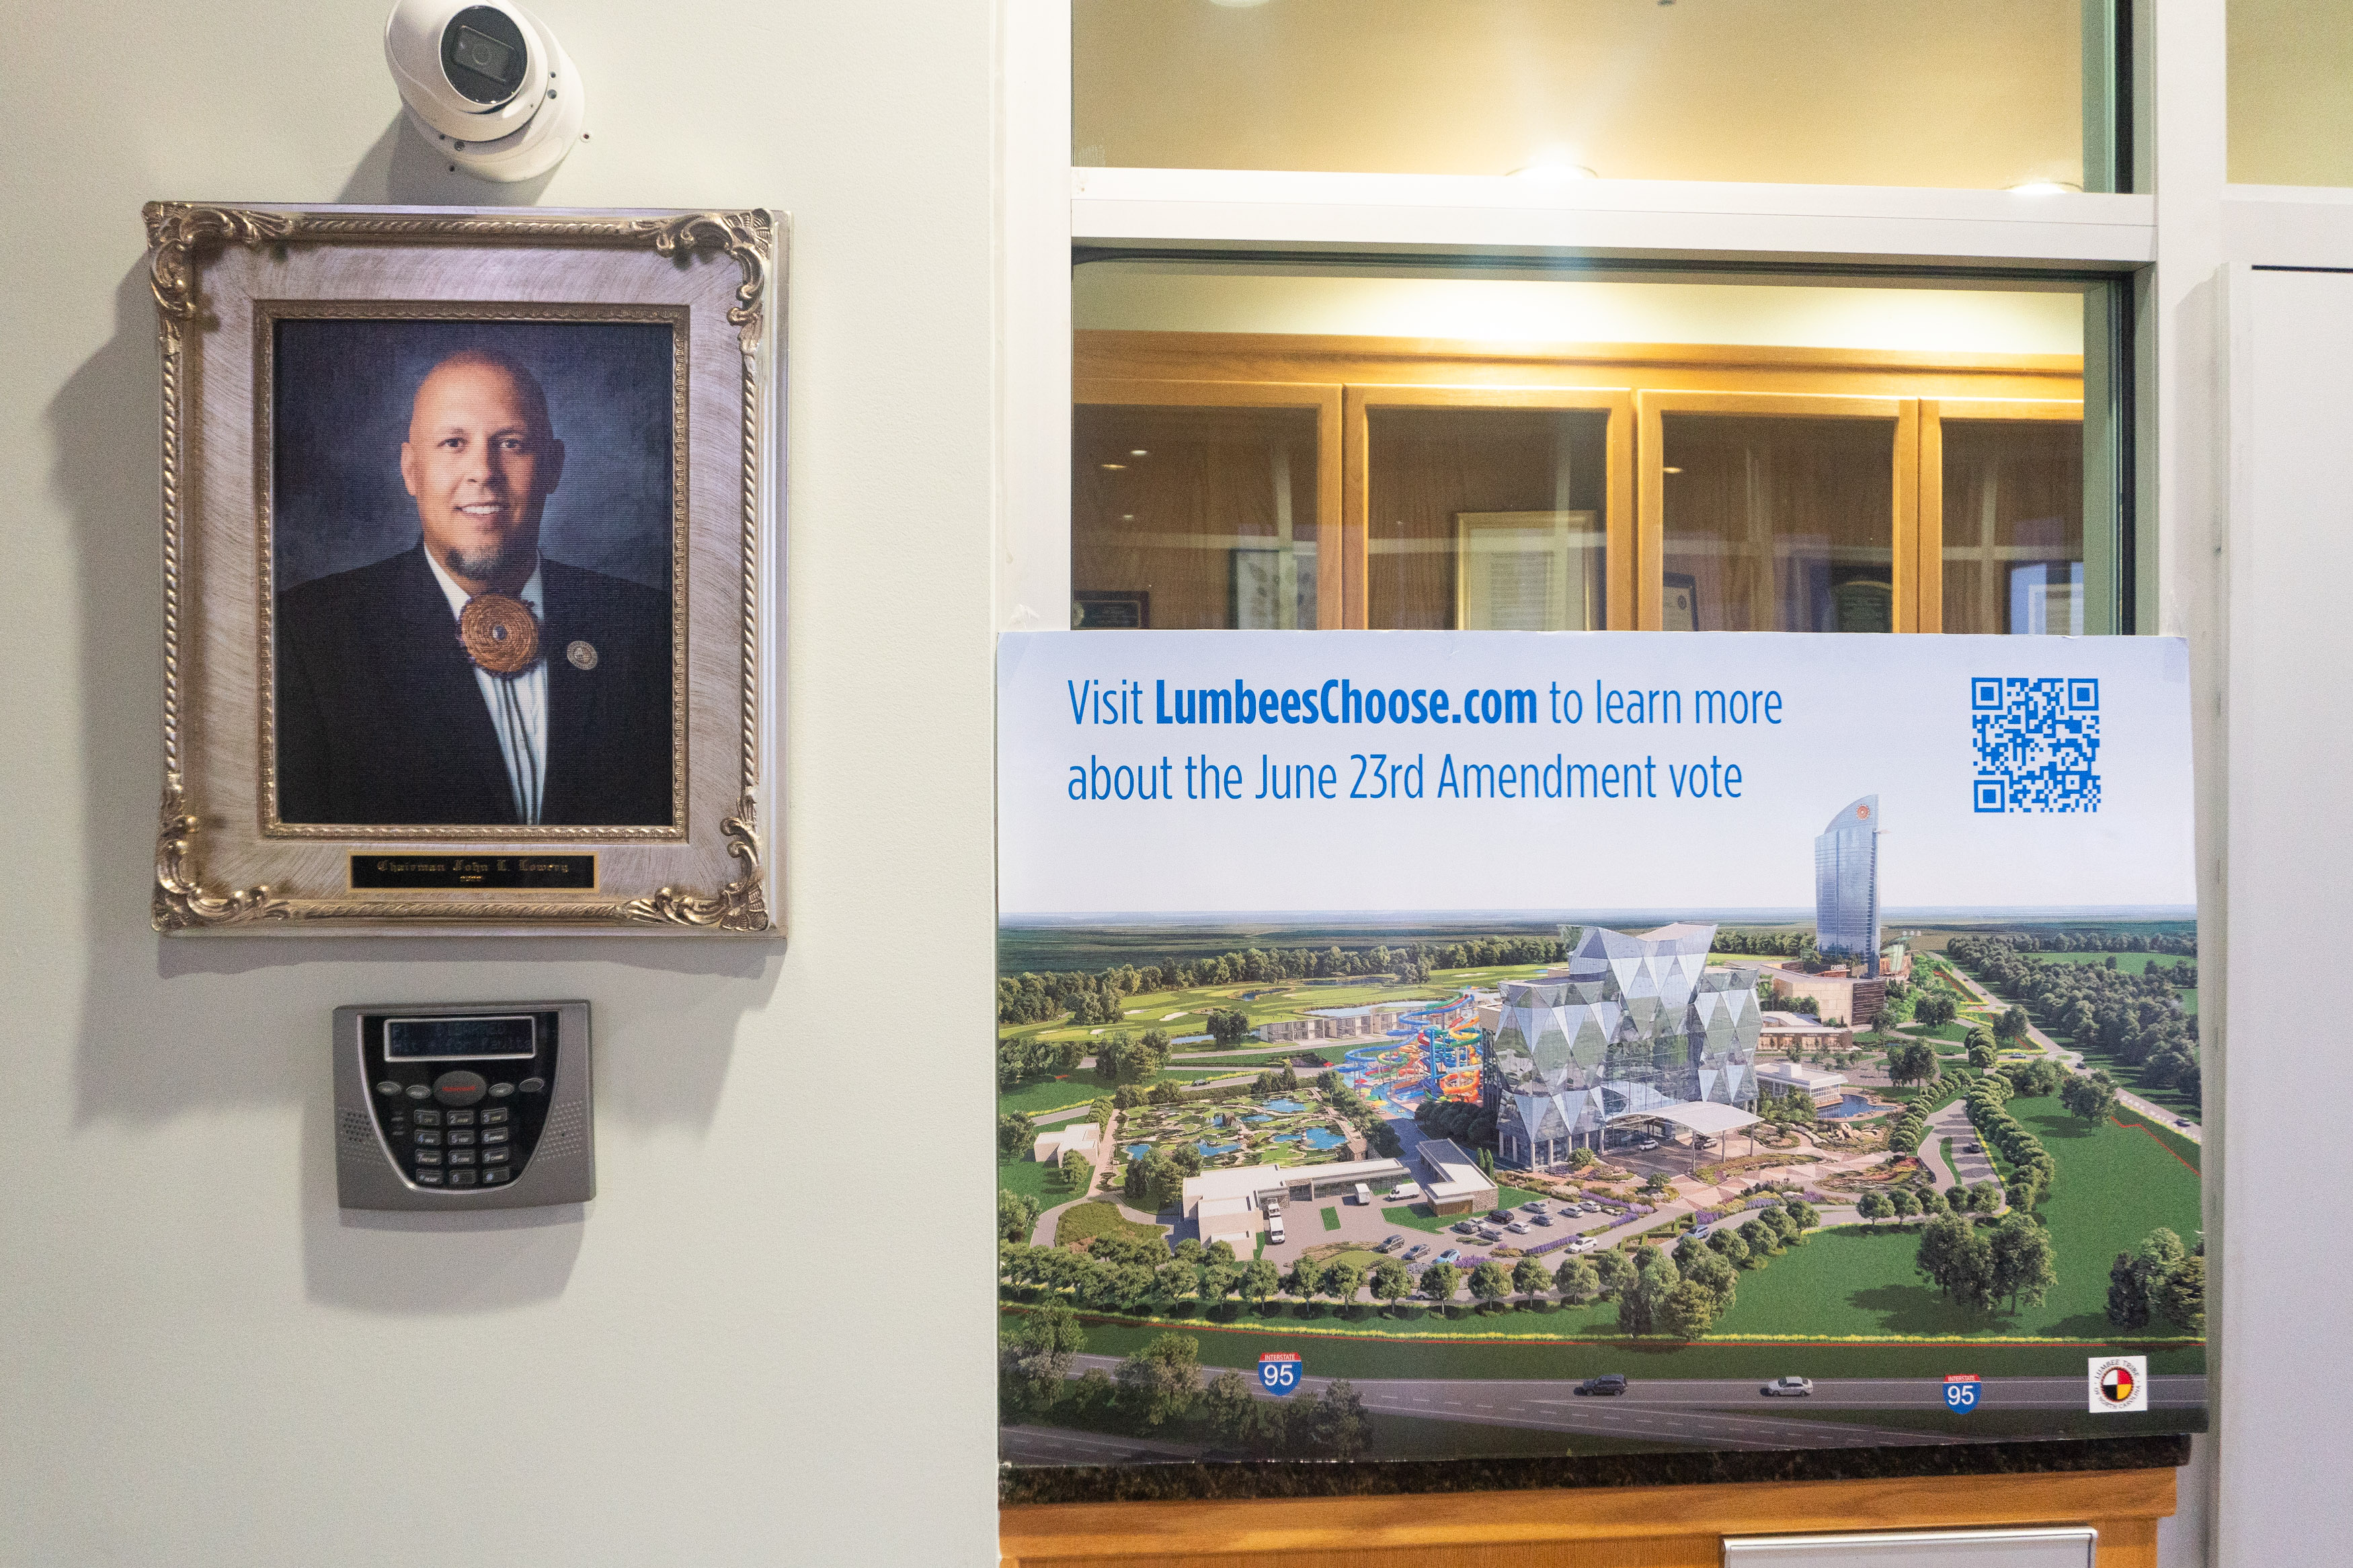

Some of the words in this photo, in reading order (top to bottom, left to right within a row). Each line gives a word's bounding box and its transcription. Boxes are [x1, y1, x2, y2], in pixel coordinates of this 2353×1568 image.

[1068, 679, 1143, 725] Visit
[1156, 679, 1537, 725] LumbeesChoose.com
[1549, 681, 1583, 724] to
[1596, 679, 1681, 725] learn
[1695, 690, 1783, 725] more
[1068, 754, 1173, 800] about
[1185, 753, 1243, 800] the
[1254, 753, 1337, 800] June
[1349, 753, 1423, 799] 23rd
[1437, 753, 1657, 798] Amendment
[1669, 755, 1743, 798] vote
[376, 860, 444, 872] Chairman
[452, 860, 488, 872] John
[450, 1116, 456, 1124] 2
[483, 1114, 489, 1122] 3
[1264, 1364, 1293, 1386] 95
[2094, 1359, 2120, 1380] LUMBEE
[1948, 1385, 1975, 1405] 95
